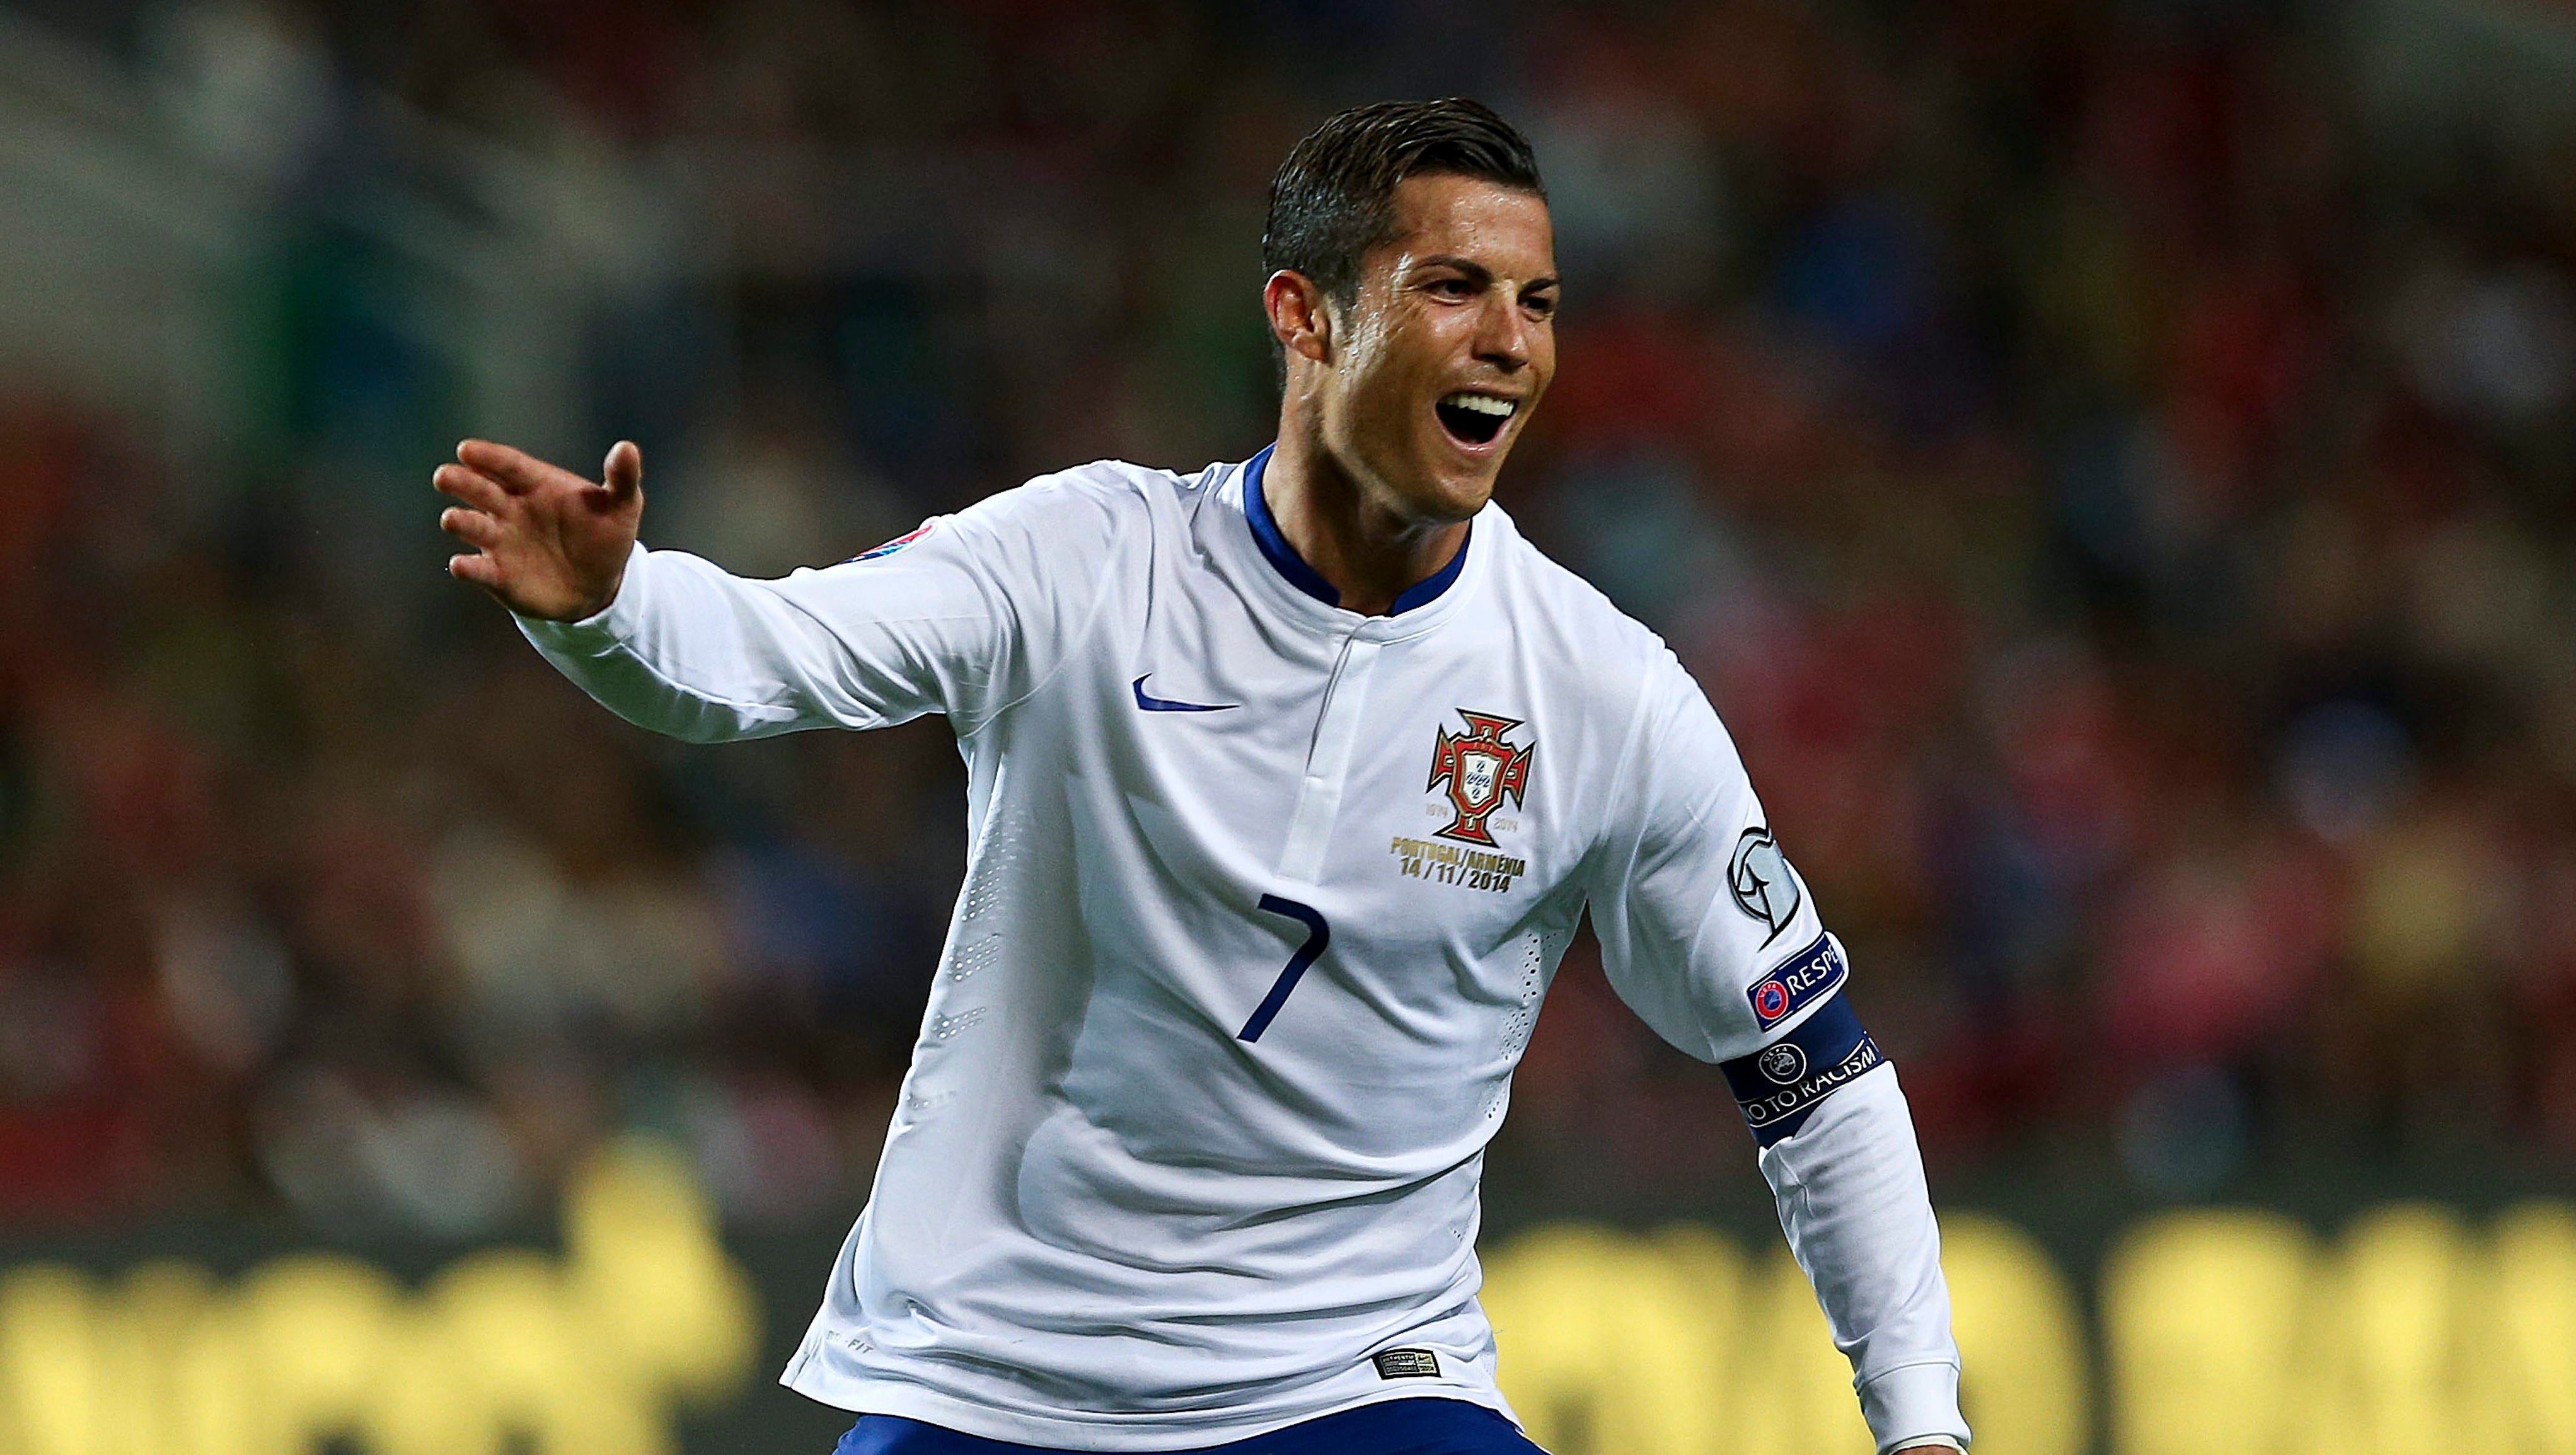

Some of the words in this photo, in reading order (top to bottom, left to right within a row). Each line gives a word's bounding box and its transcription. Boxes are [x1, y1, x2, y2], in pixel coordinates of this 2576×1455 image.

[1236, 893, 1330, 1044] 7
[1765, 1090, 1797, 1112] TO
[1798, 1045, 1877, 1098] RACISM
